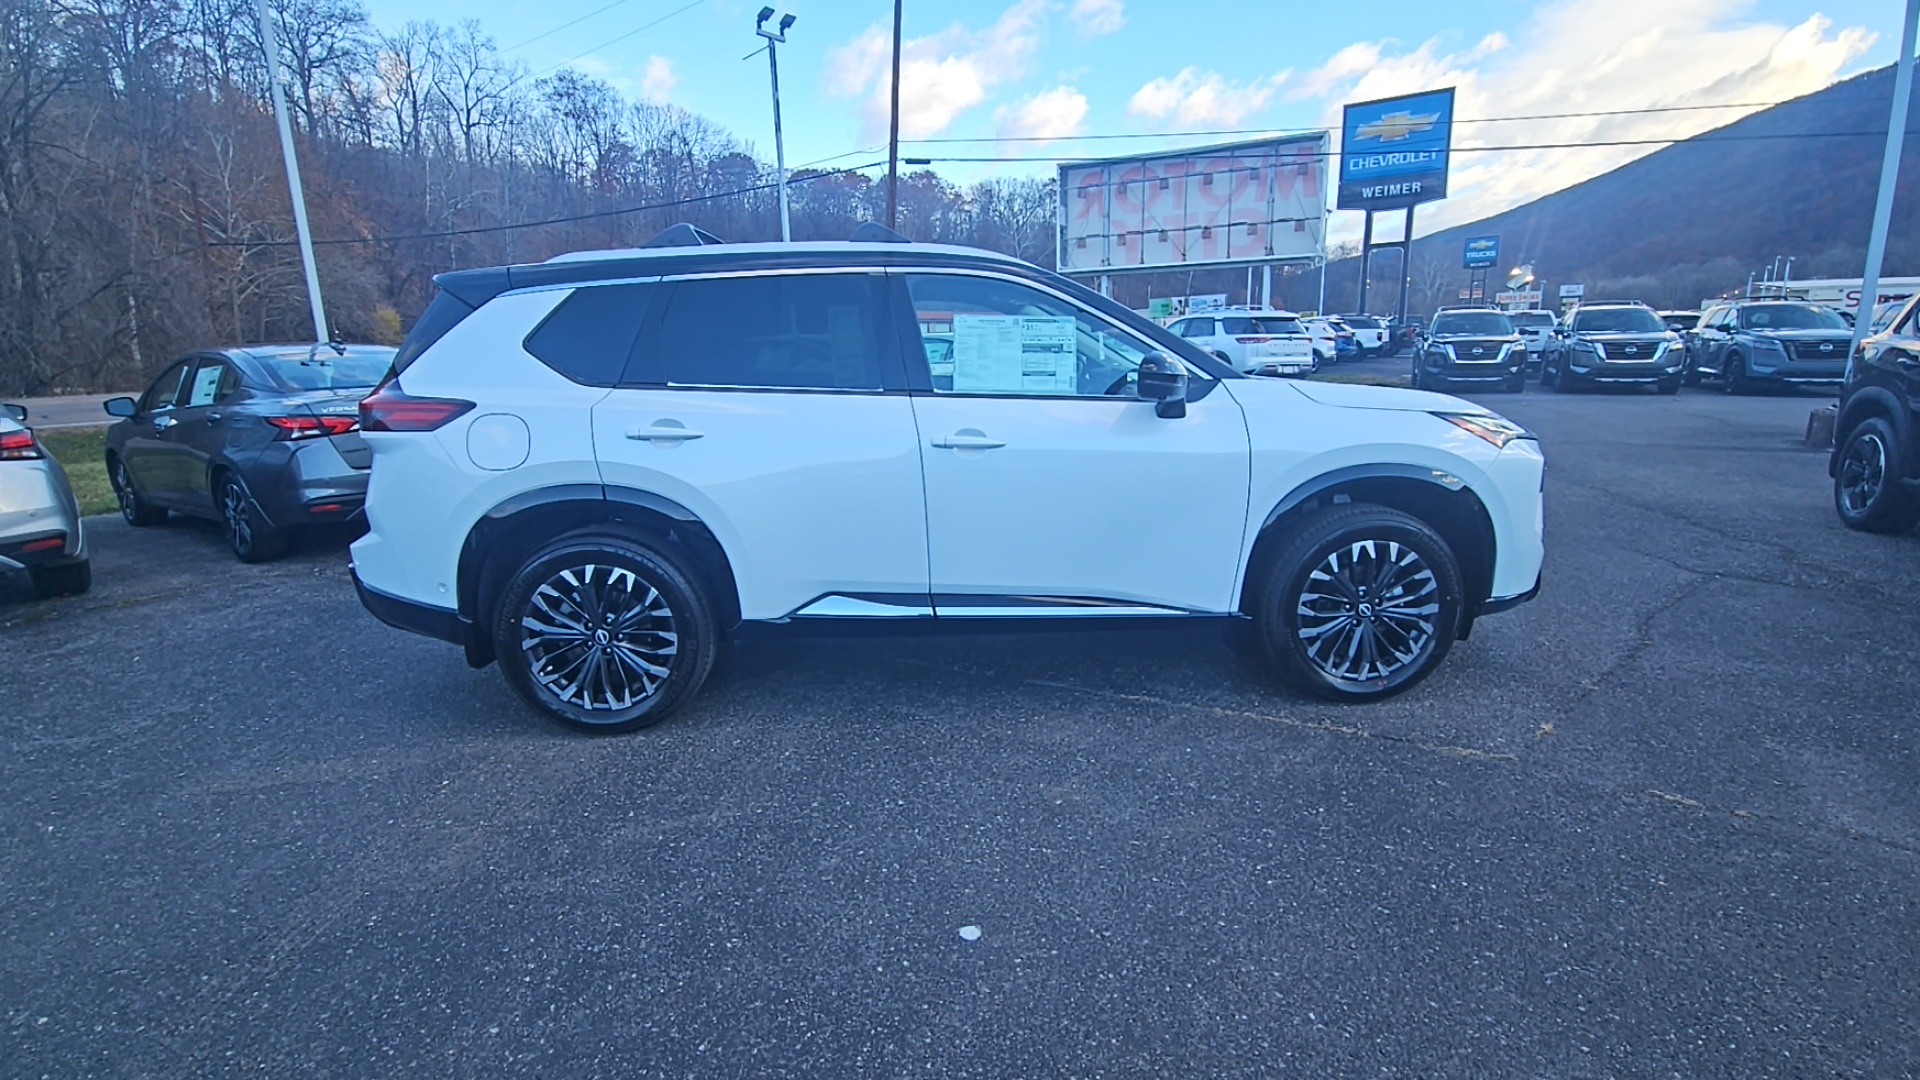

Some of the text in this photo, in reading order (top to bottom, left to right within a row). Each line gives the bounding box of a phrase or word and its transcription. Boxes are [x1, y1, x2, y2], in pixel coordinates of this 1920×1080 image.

[1349, 148, 1440, 171] CHEVROLET
[1362, 181, 1422, 198] WEIMER
[1466, 250, 1496, 259] TRUCKS
